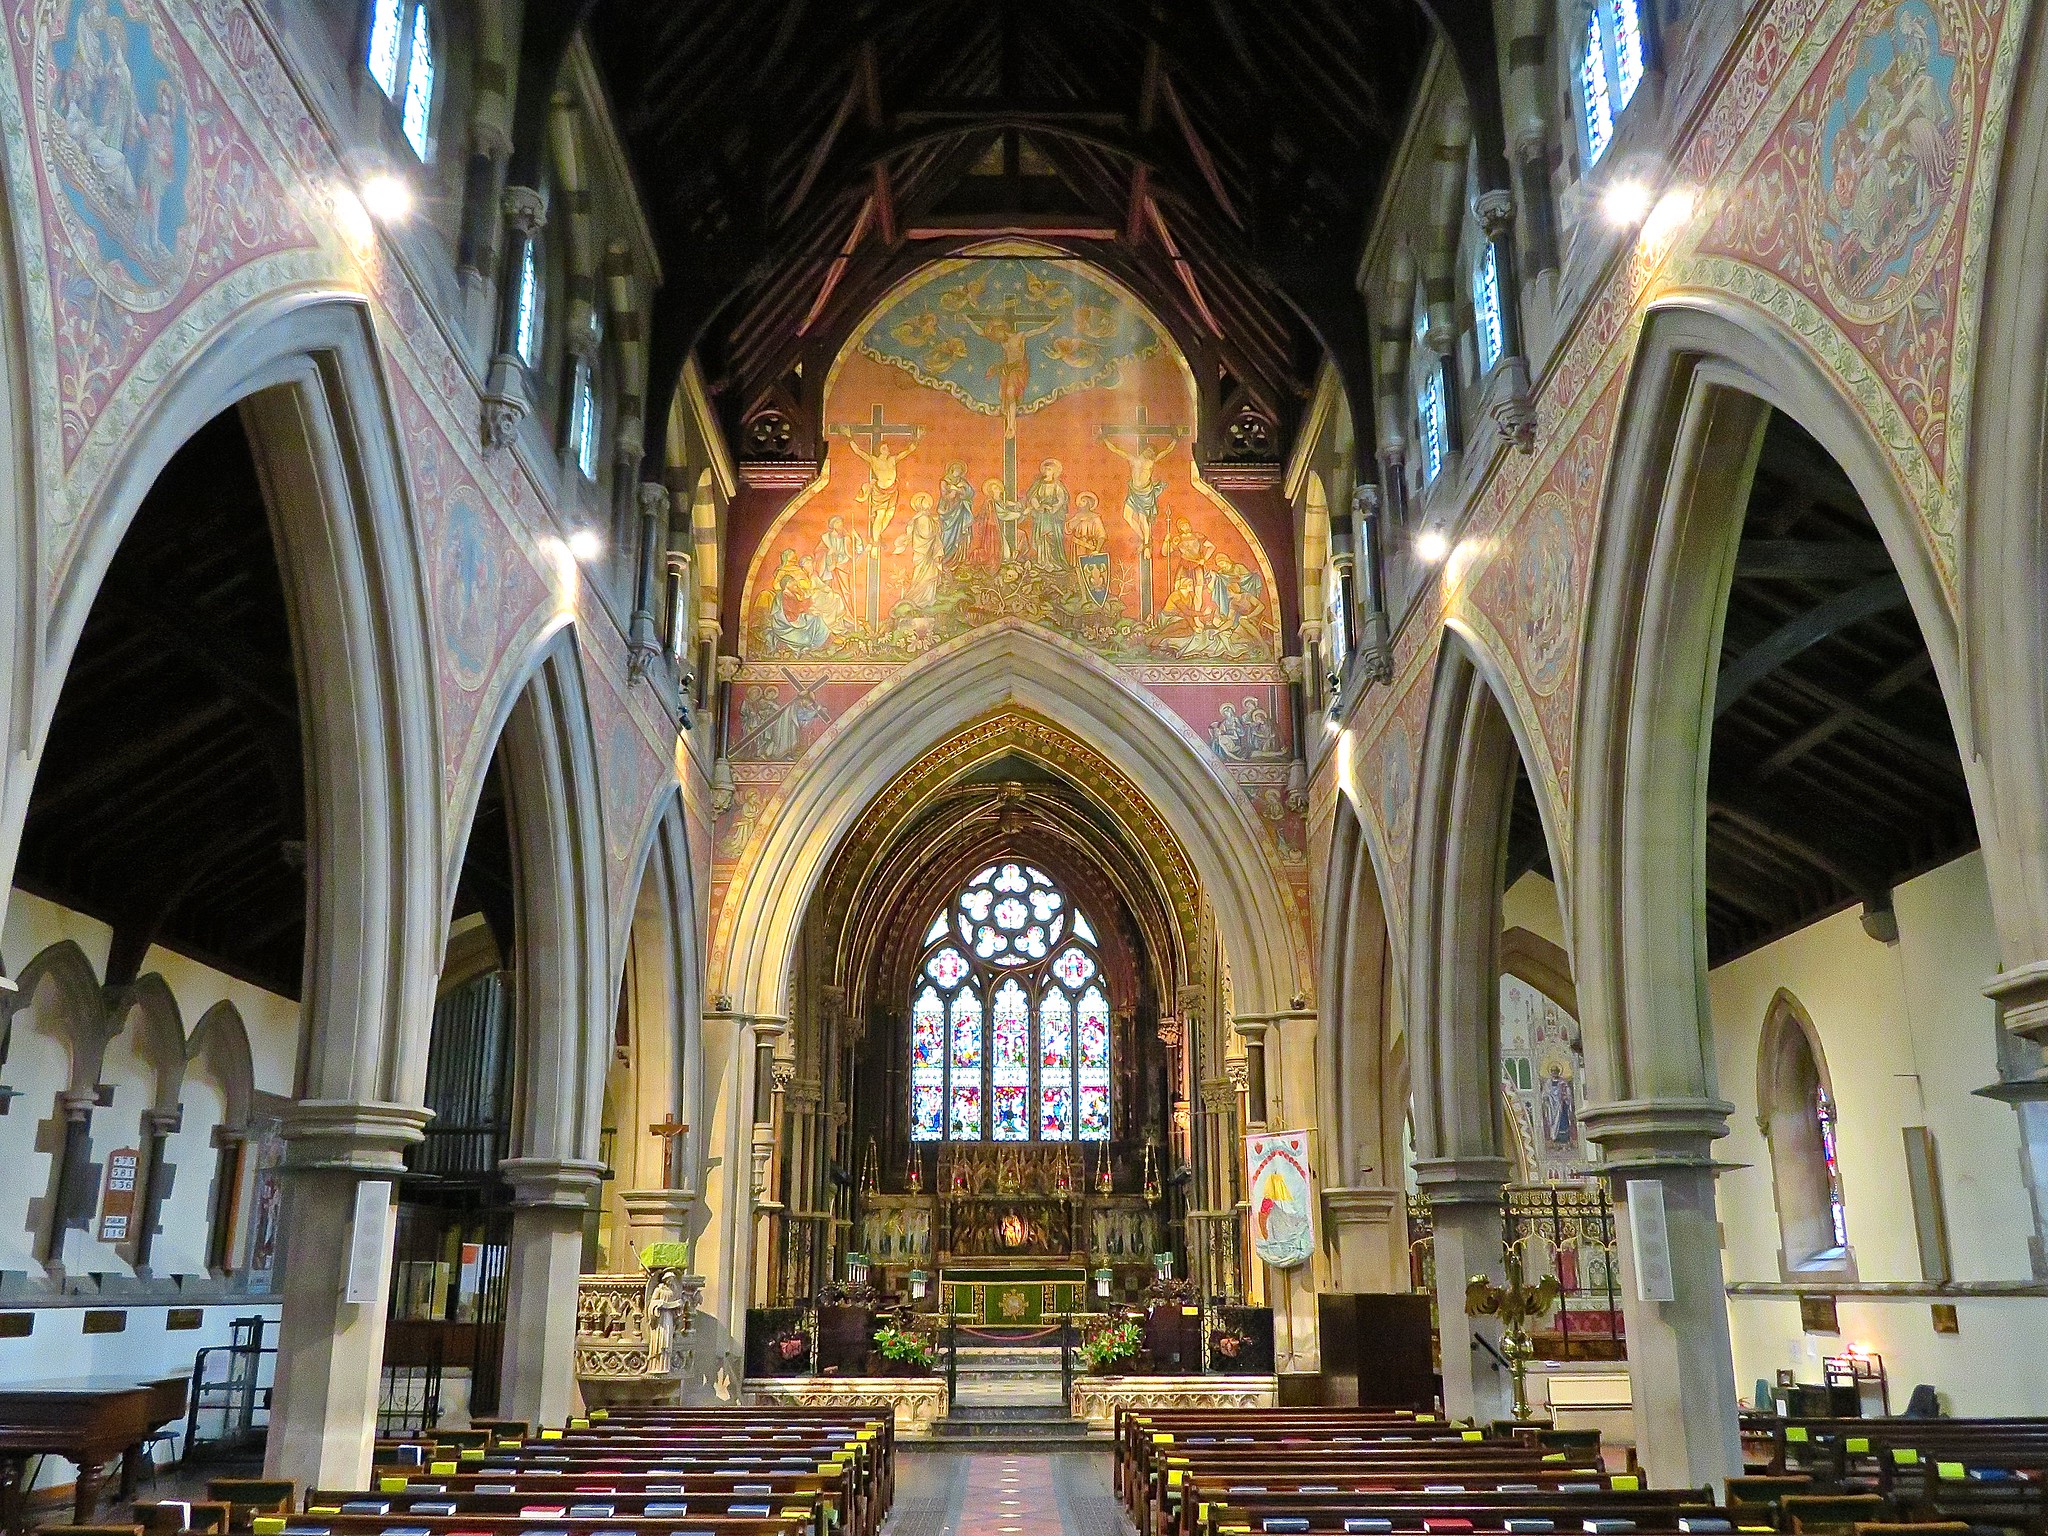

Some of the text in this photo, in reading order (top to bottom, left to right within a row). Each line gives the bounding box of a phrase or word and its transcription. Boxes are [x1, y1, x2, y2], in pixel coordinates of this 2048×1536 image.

[113, 1168, 133, 1177] 581
[111, 1180, 132, 1189] 536
[105, 1229, 125, 1237] 119
